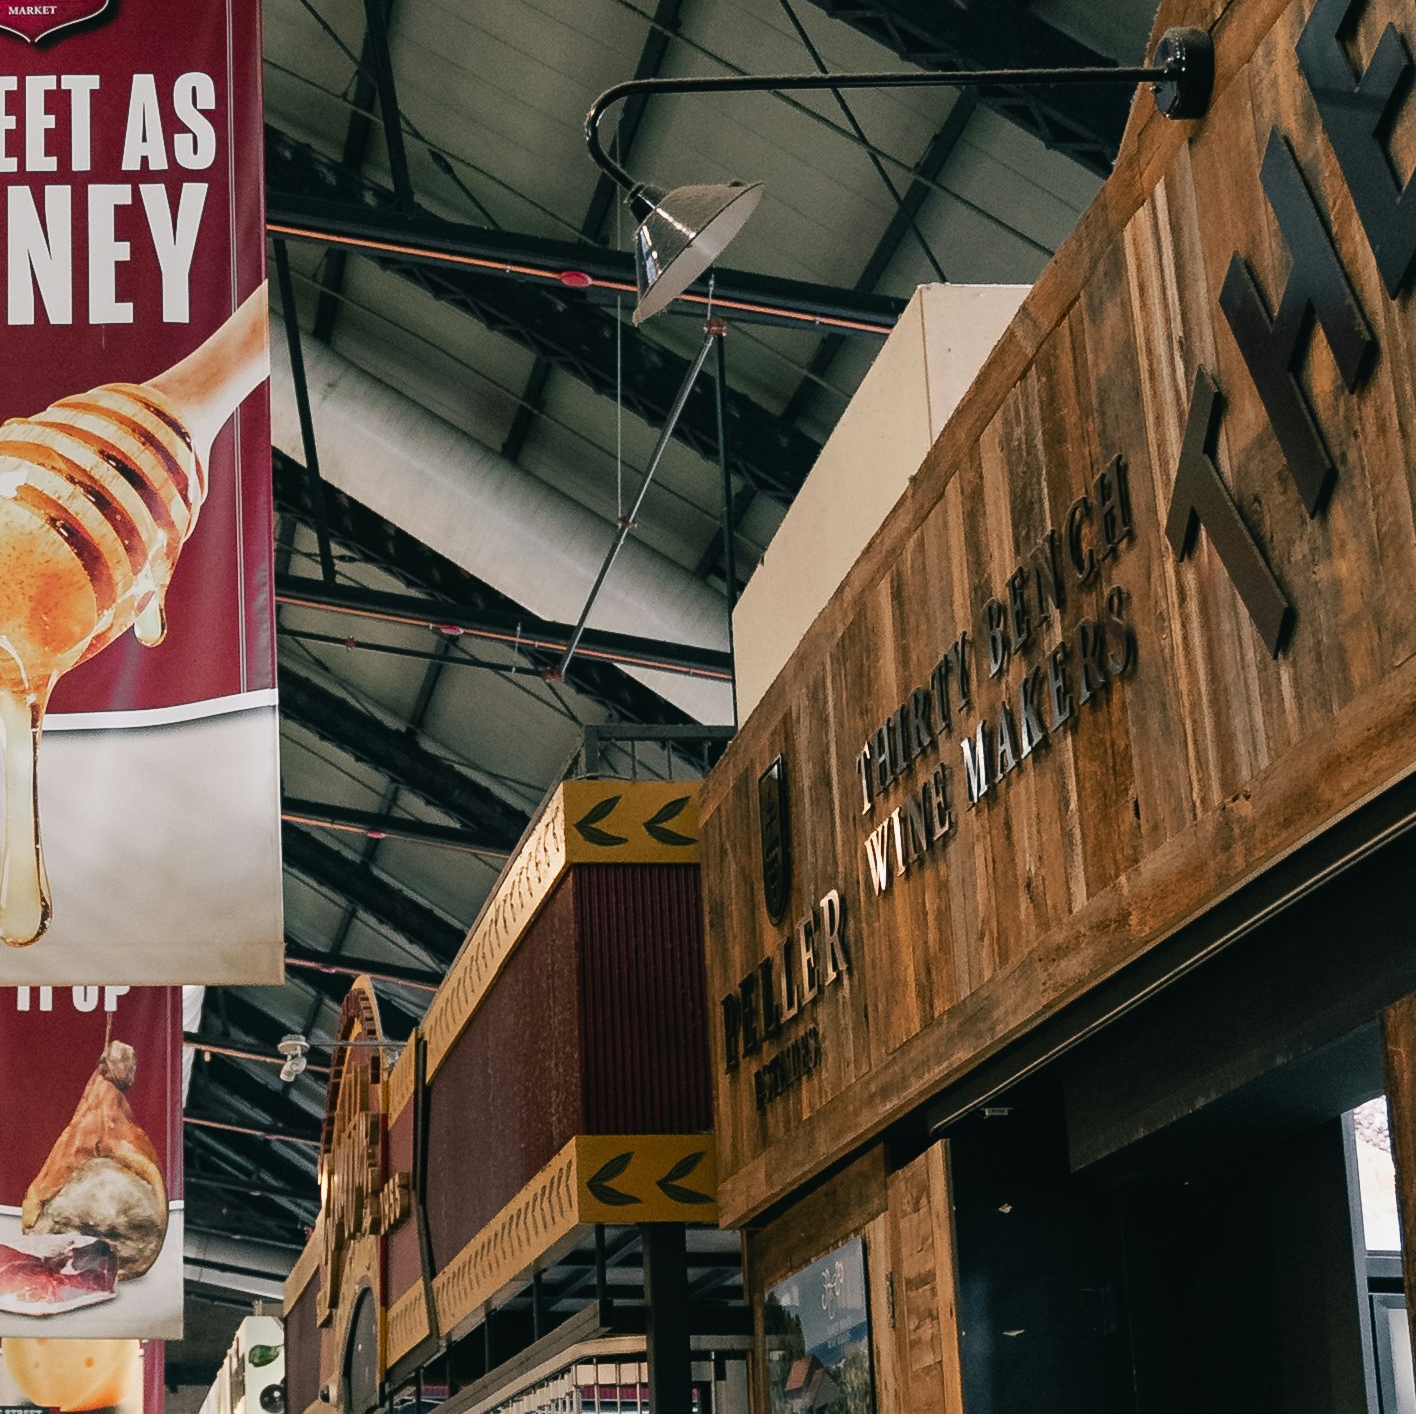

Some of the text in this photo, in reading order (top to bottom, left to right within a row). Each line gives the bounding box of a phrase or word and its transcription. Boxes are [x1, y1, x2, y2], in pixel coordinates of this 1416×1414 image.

[8, 6, 57, 15] MARKET
[121, 71, 216, 171] AS
[856, 452, 1136, 817] THIRTY BENCH
[863, 583, 1138, 898] WINE MAKERS
[72, 985, 130, 1012] UP
[720, 886, 850, 1075] PELLER
